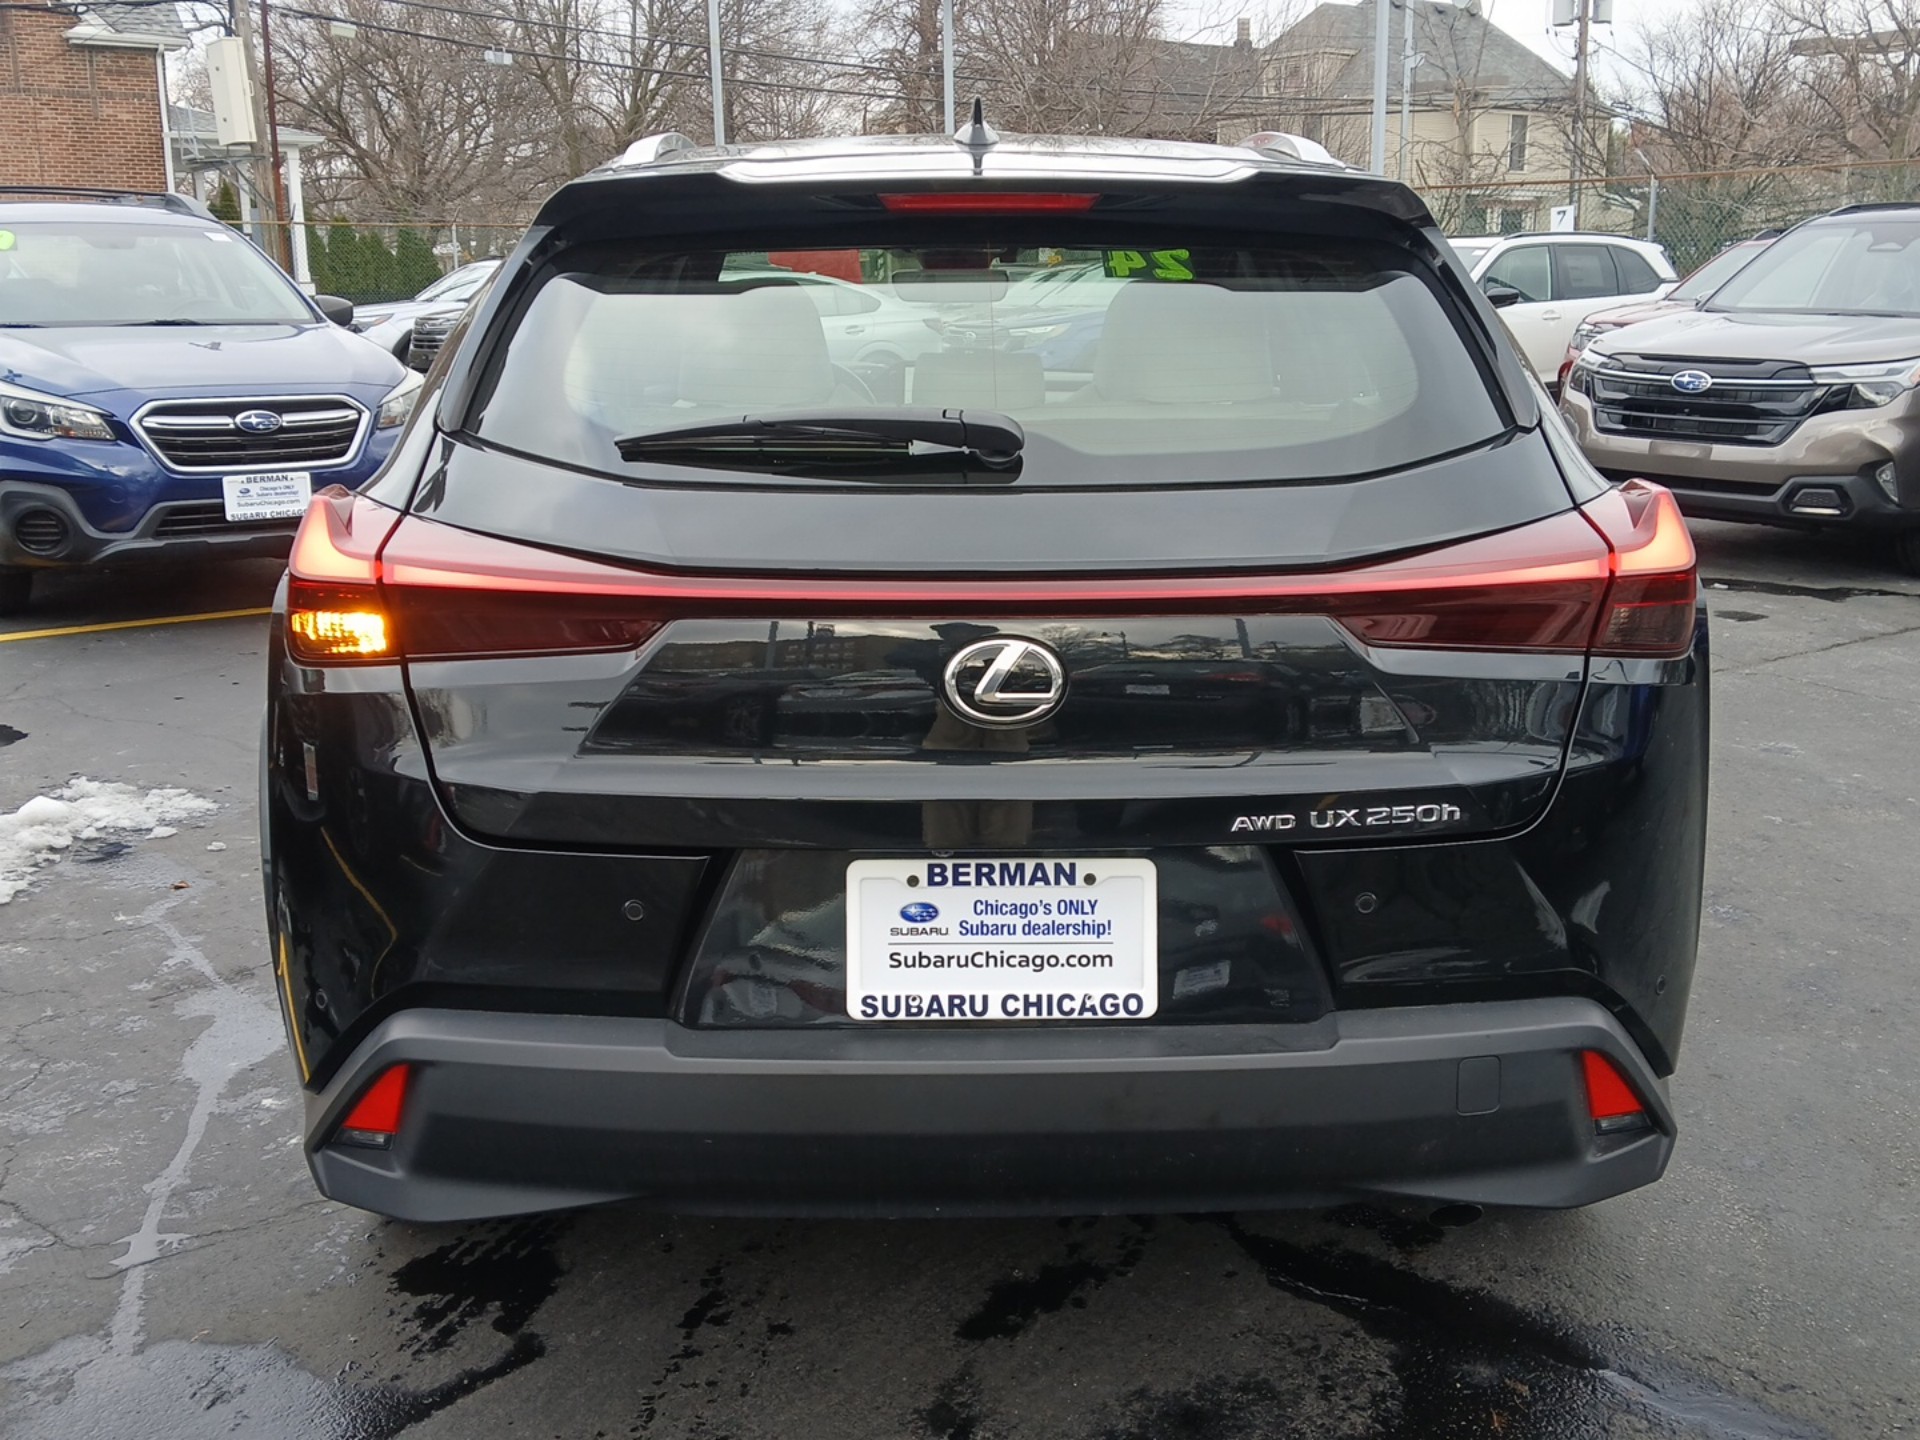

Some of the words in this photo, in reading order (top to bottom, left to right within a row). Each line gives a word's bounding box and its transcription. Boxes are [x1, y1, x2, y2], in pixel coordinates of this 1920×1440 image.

[1556, 209, 1568, 226] 7
[246, 474, 289, 484] BERMAN
[1231, 814, 1296, 832] AWD
[927, 862, 1077, 887] BERMAN
[973, 899, 1053, 919] Chicago's
[1056, 899, 1098, 915] ONLY
[890, 927, 949, 936] SUBARU
[959, 920, 1017, 936] Subaru
[1021, 919, 1112, 939] dealership!
[889, 950, 1114, 972] SubaruChicago.com
[860, 994, 989, 1018] SUBARU
[1000, 992, 1144, 1017] CHICAGO
